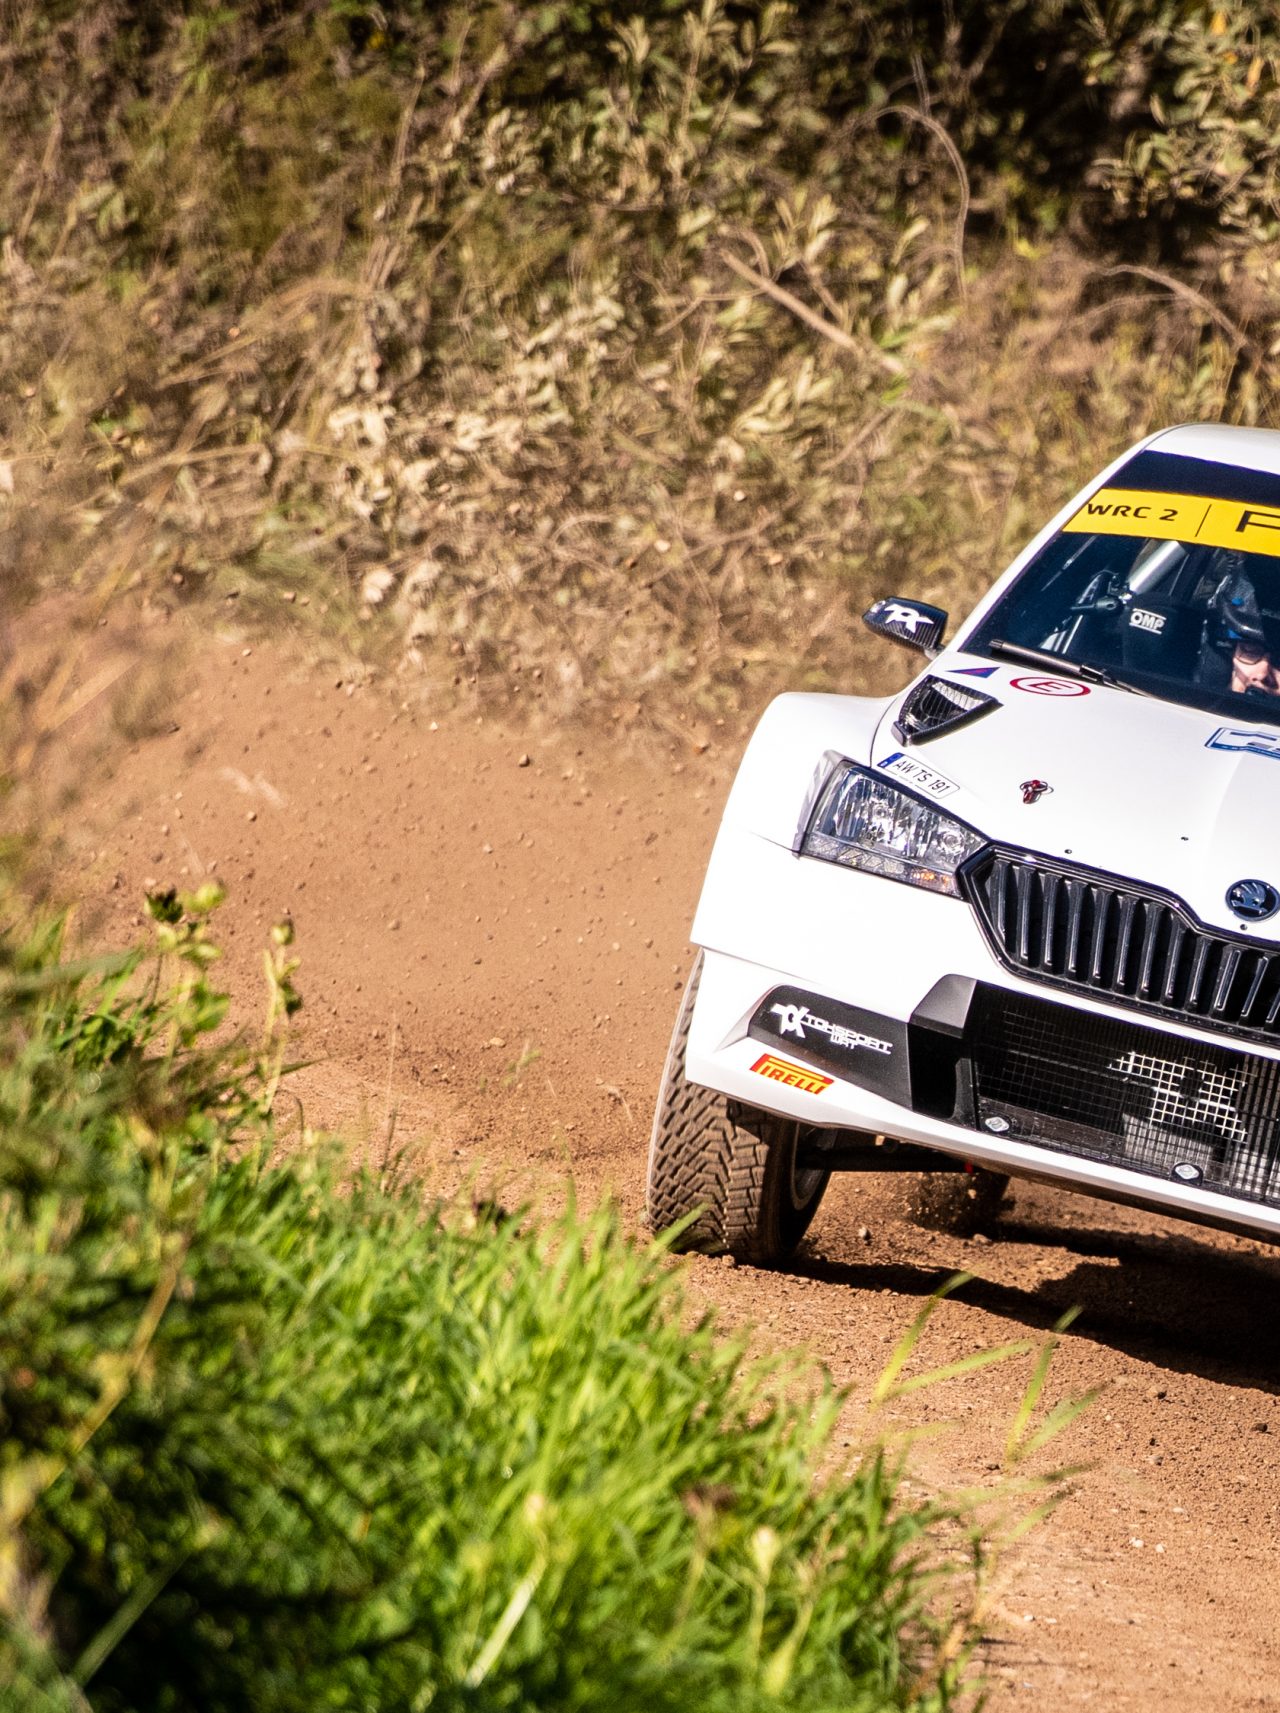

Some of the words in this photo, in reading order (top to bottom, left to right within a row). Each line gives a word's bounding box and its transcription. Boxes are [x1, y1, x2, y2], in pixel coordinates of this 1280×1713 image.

[1087, 503, 1152, 520] WRC
[1159, 508, 1178, 522] 2
[1130, 610, 1165, 632] OMP
[892, 760, 919, 774] AW
[912, 769, 933, 783] TS
[927, 779, 951, 794] 191
[750, 1053, 835, 1095] PIRELLI
